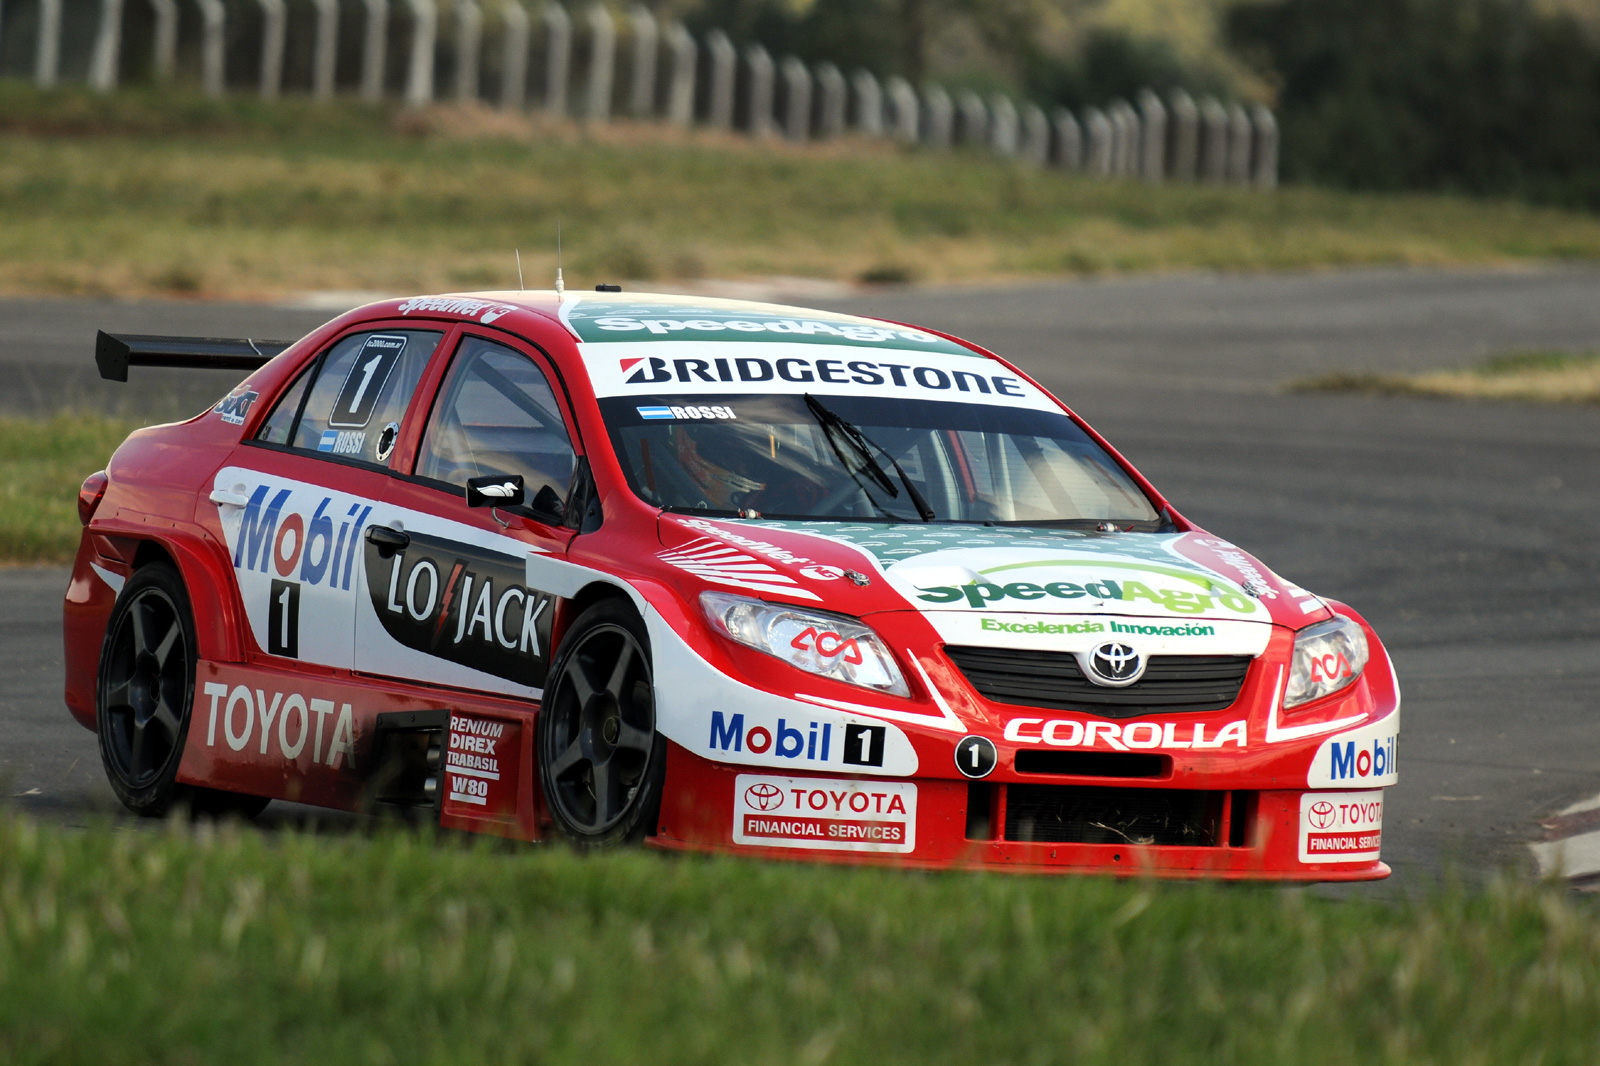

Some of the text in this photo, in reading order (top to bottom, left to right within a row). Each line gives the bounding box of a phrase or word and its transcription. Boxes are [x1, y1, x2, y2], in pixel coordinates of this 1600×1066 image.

[594, 317, 938, 343] SpeedAgro
[349, 354, 383, 414] 1
[625, 357, 1026, 397] BRIDGESTONE
[670, 406, 737, 419] ROSSI
[333, 431, 366, 454] ROSSI
[236, 485, 373, 591] Mobil
[277, 586, 291, 649] 1
[981, 618, 1215, 637] Excelencia Innovación
[203, 681, 356, 769] TOYOTA
[450, 716, 504, 738] RENIUM
[709, 711, 873, 762] Mobil 1
[1004, 718, 1248, 751] COROLLA
[450, 733, 496, 755] DIREX
[968, 743, 979, 768] 1
[447, 751, 499, 772] TRABASIL
[1330, 736, 1395, 780] Mobil
[452, 776, 488, 797] W80
[791, 789, 906, 815] TOYOTA
[747, 820, 901, 840] FINANCIAL SERVICES
[1310, 834, 1380, 851] FINANCIAL SERVICE
